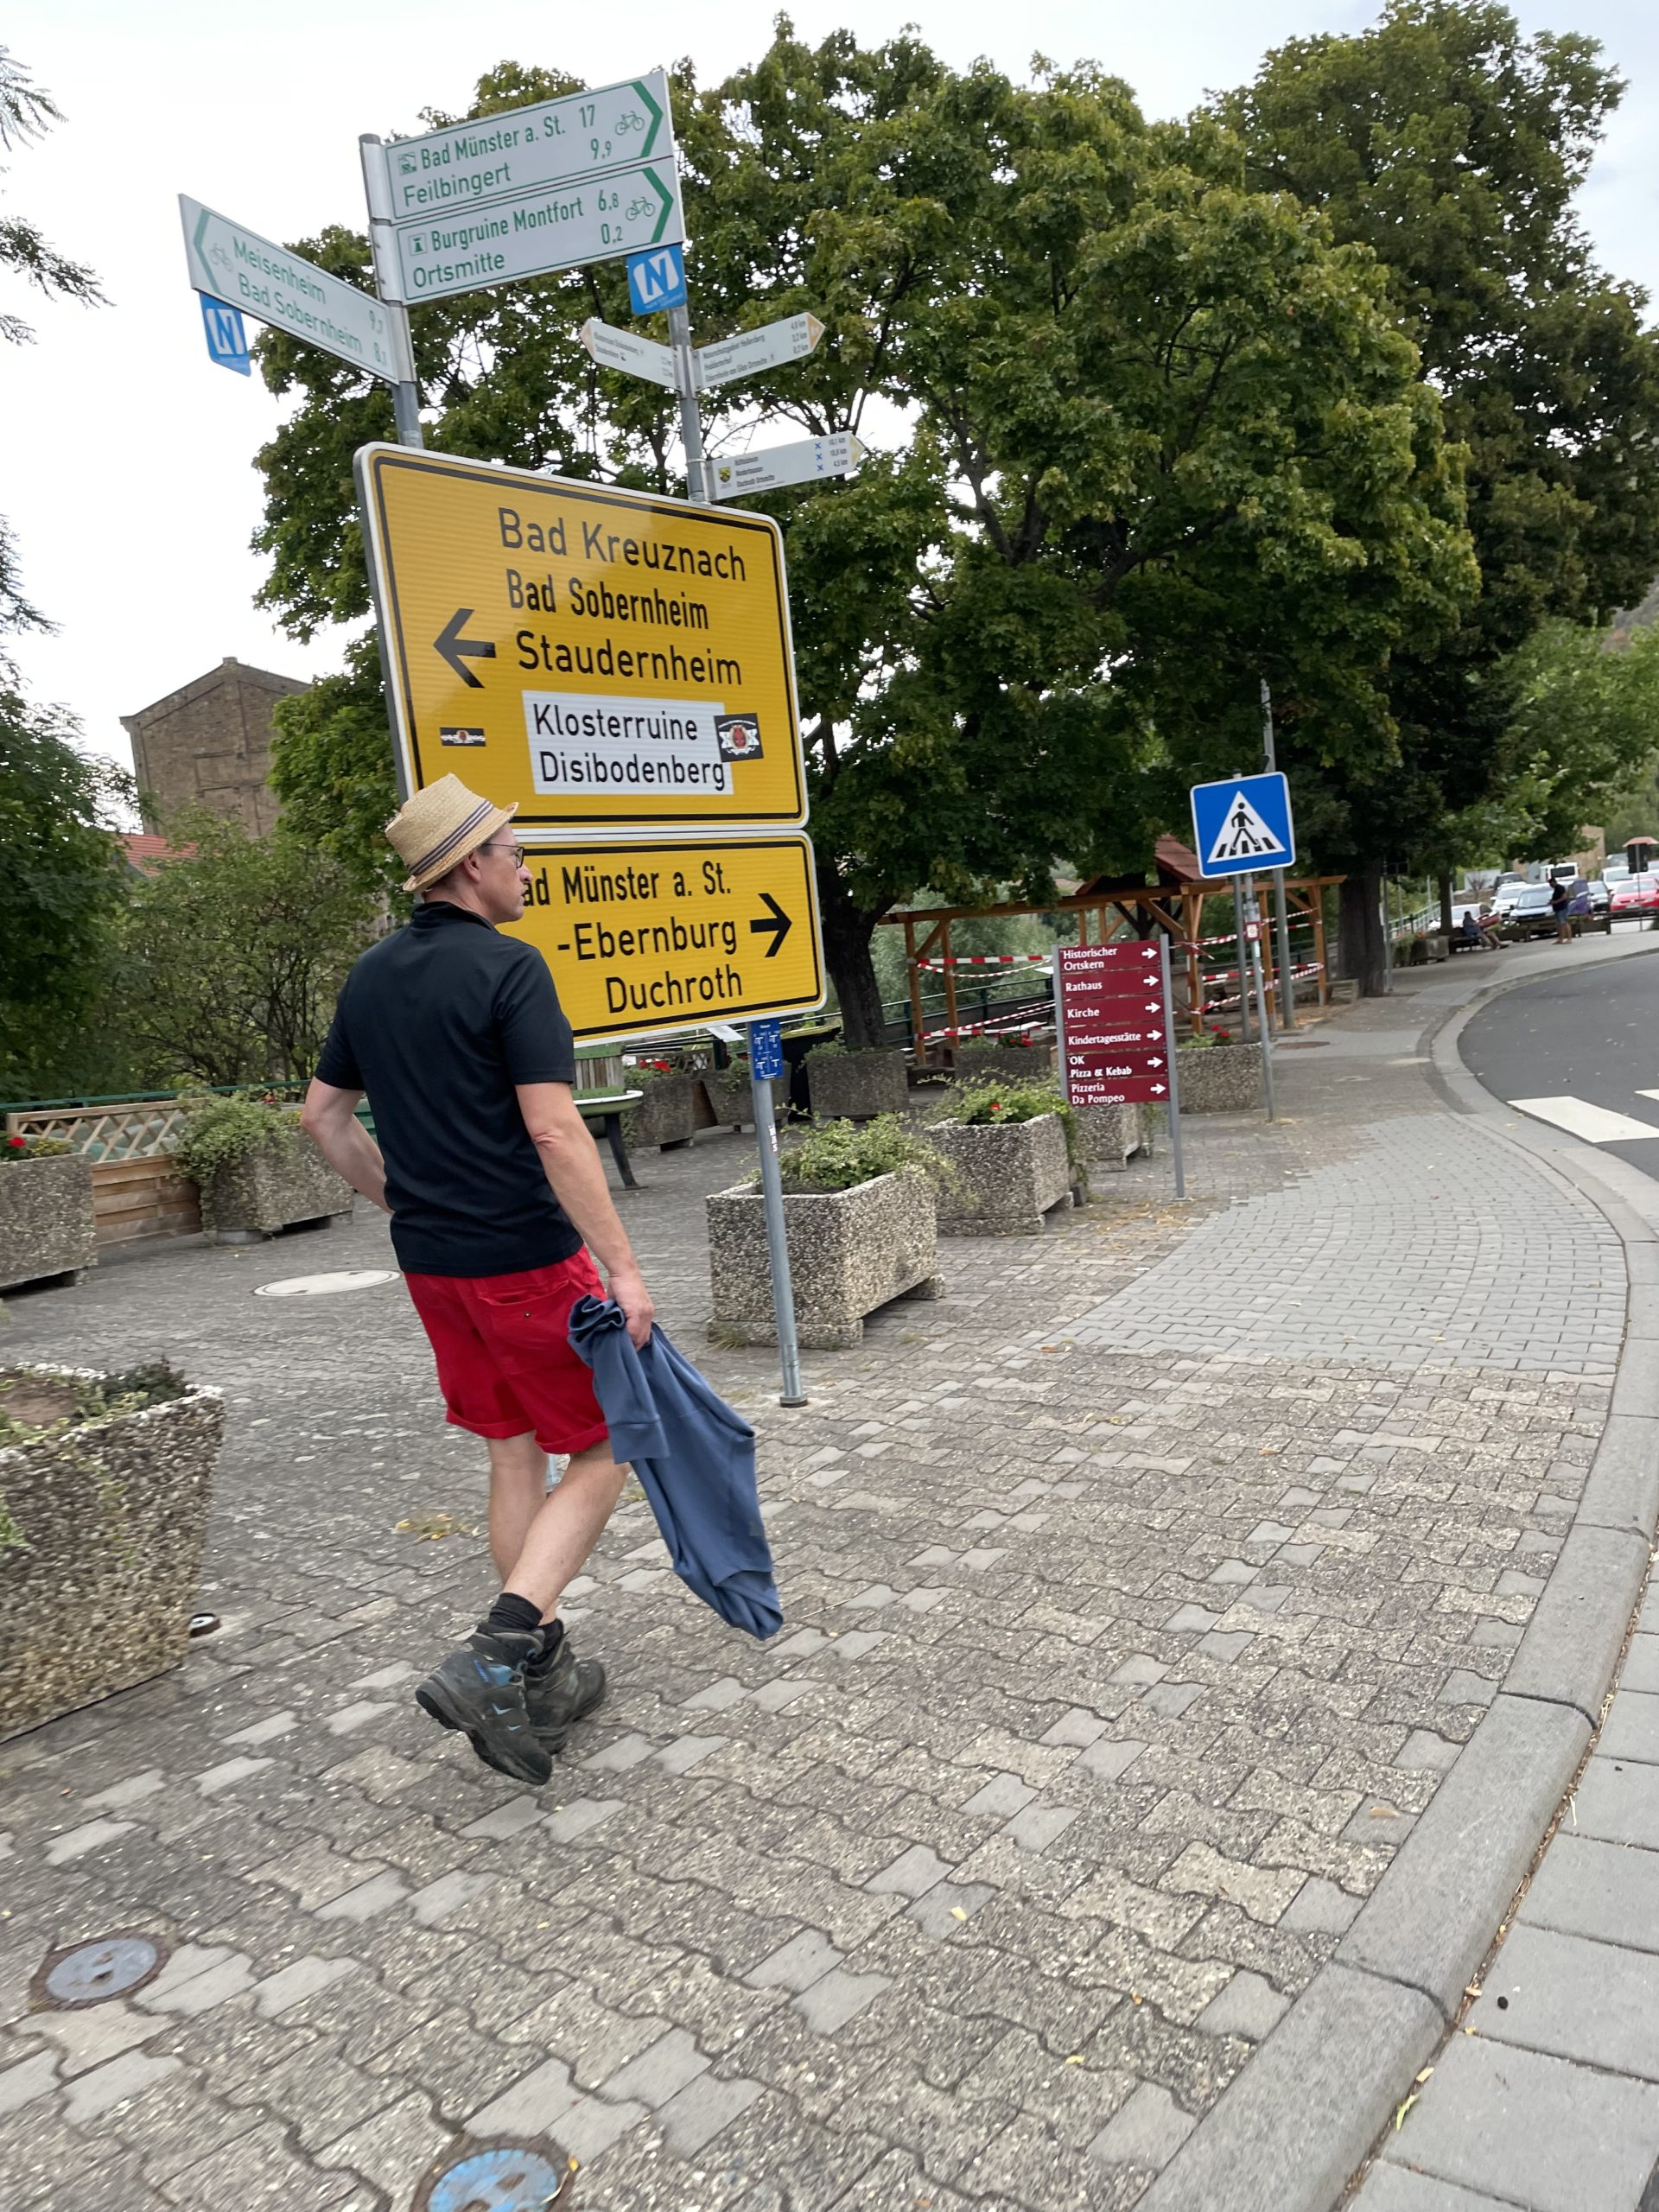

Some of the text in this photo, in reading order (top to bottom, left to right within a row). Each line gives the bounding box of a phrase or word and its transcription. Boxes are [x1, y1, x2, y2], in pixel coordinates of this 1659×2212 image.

[421, 105, 596, 169] Bad Münster a. St. 17
[404, 138, 612, 207] Feilbingert 9,9
[431, 189, 620, 251] Burgruine Montfort 6,8
[232, 236, 327, 304] Meisenheim
[413, 223, 623, 288] Ortsmitte 0,2
[238, 273, 270, 308] Bad
[275, 292, 363, 354] Sobernheim
[498, 506, 747, 582] Bad Kreuznach
[506, 569, 709, 630] Bad Sobernheim
[517, 630, 743, 685] Staudernheim
[533, 702, 698, 741] Klosterruine
[540, 751, 726, 791] Disibodenberg
[523, 861, 732, 906] ad Münster a. St.
[557, 916, 737, 961] -Ebernburg
[1063, 946, 1118, 960] Historischer
[1064, 960, 1105, 971] Ortskern
[1065, 981, 1103, 992] Rathaus
[606, 963, 743, 1014] Duchroth
[1067, 1007, 1100, 1019] Kirche
[1068, 1032, 1141, 1046] Kindertagesstätte
[1070, 1055, 1085, 1065] OK
[1071, 1065, 1133, 1078] Pizza & Kebab
[1071, 1082, 1105, 1093] Pizzeria
[1072, 1094, 1125, 1105] Da Pompeo
